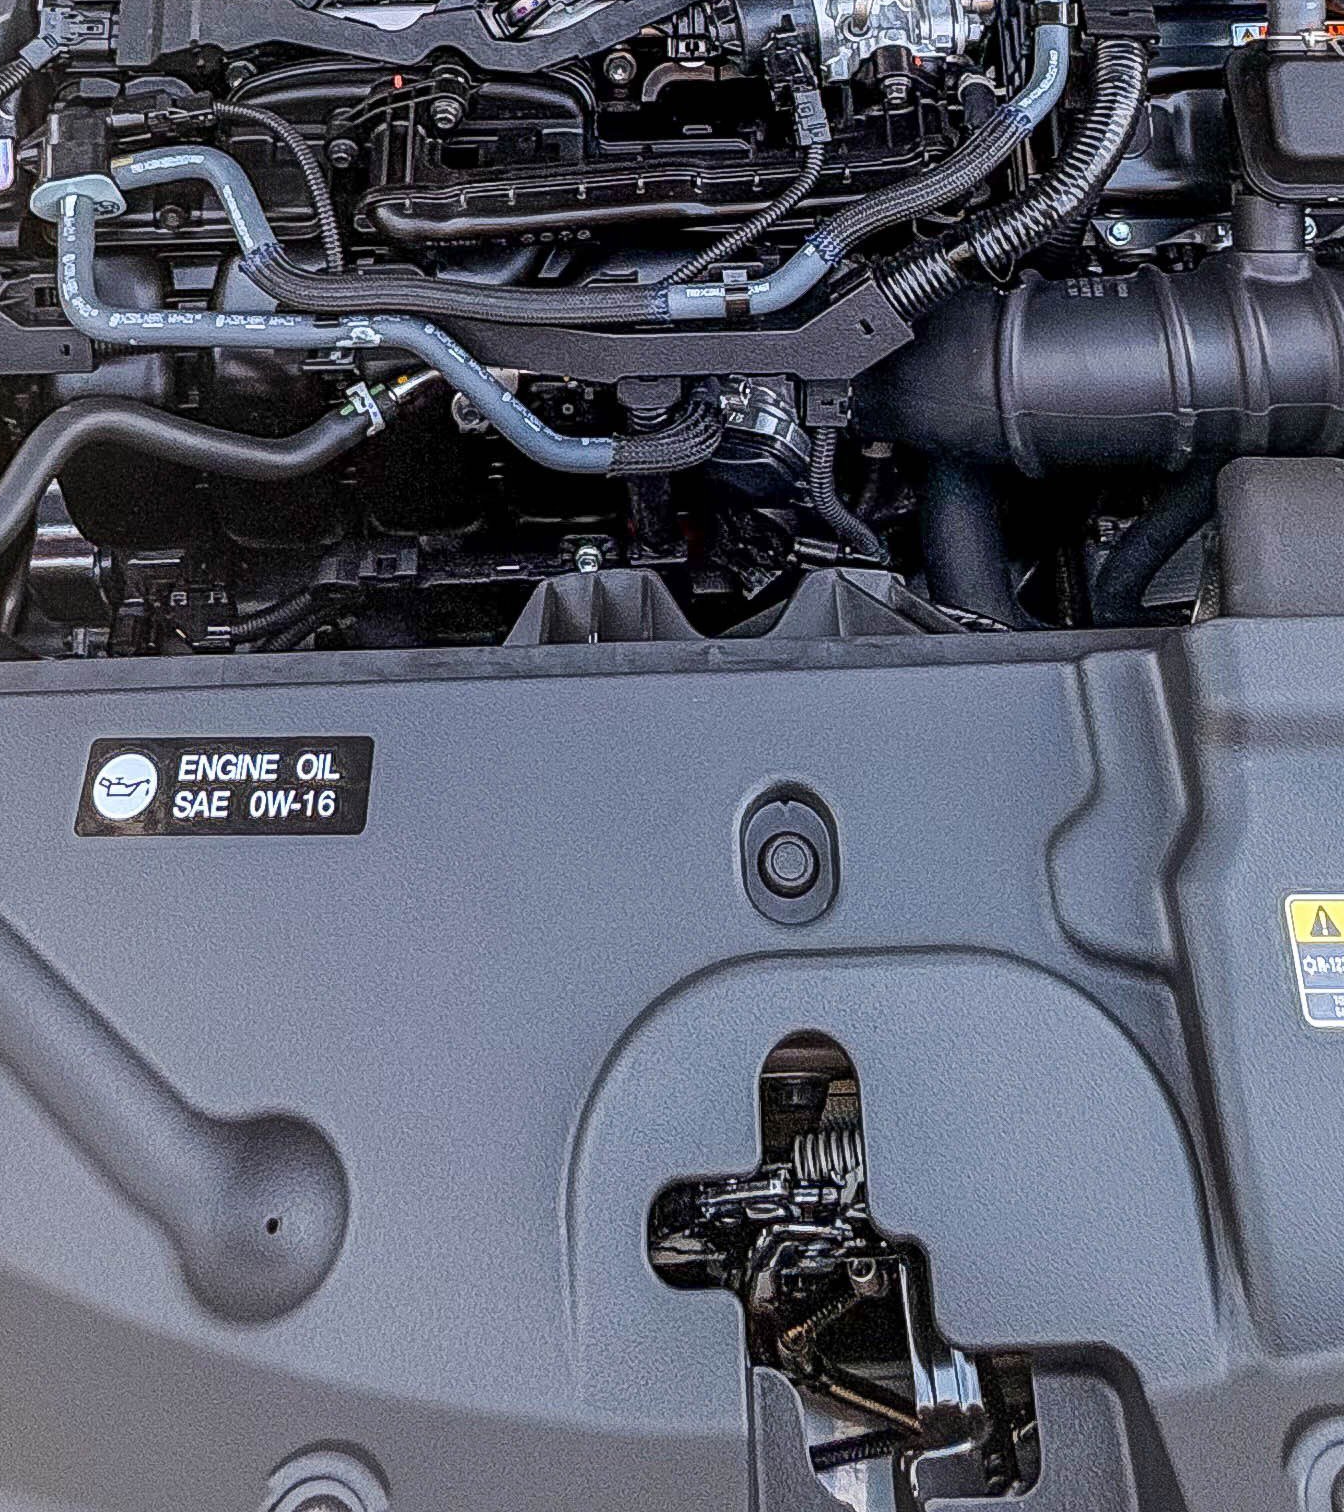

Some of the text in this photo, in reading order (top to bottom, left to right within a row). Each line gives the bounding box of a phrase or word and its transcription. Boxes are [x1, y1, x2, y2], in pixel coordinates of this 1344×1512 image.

[177, 753, 341, 781] ENGINE OIL
[172, 790, 336, 818] SAE 0W-16
